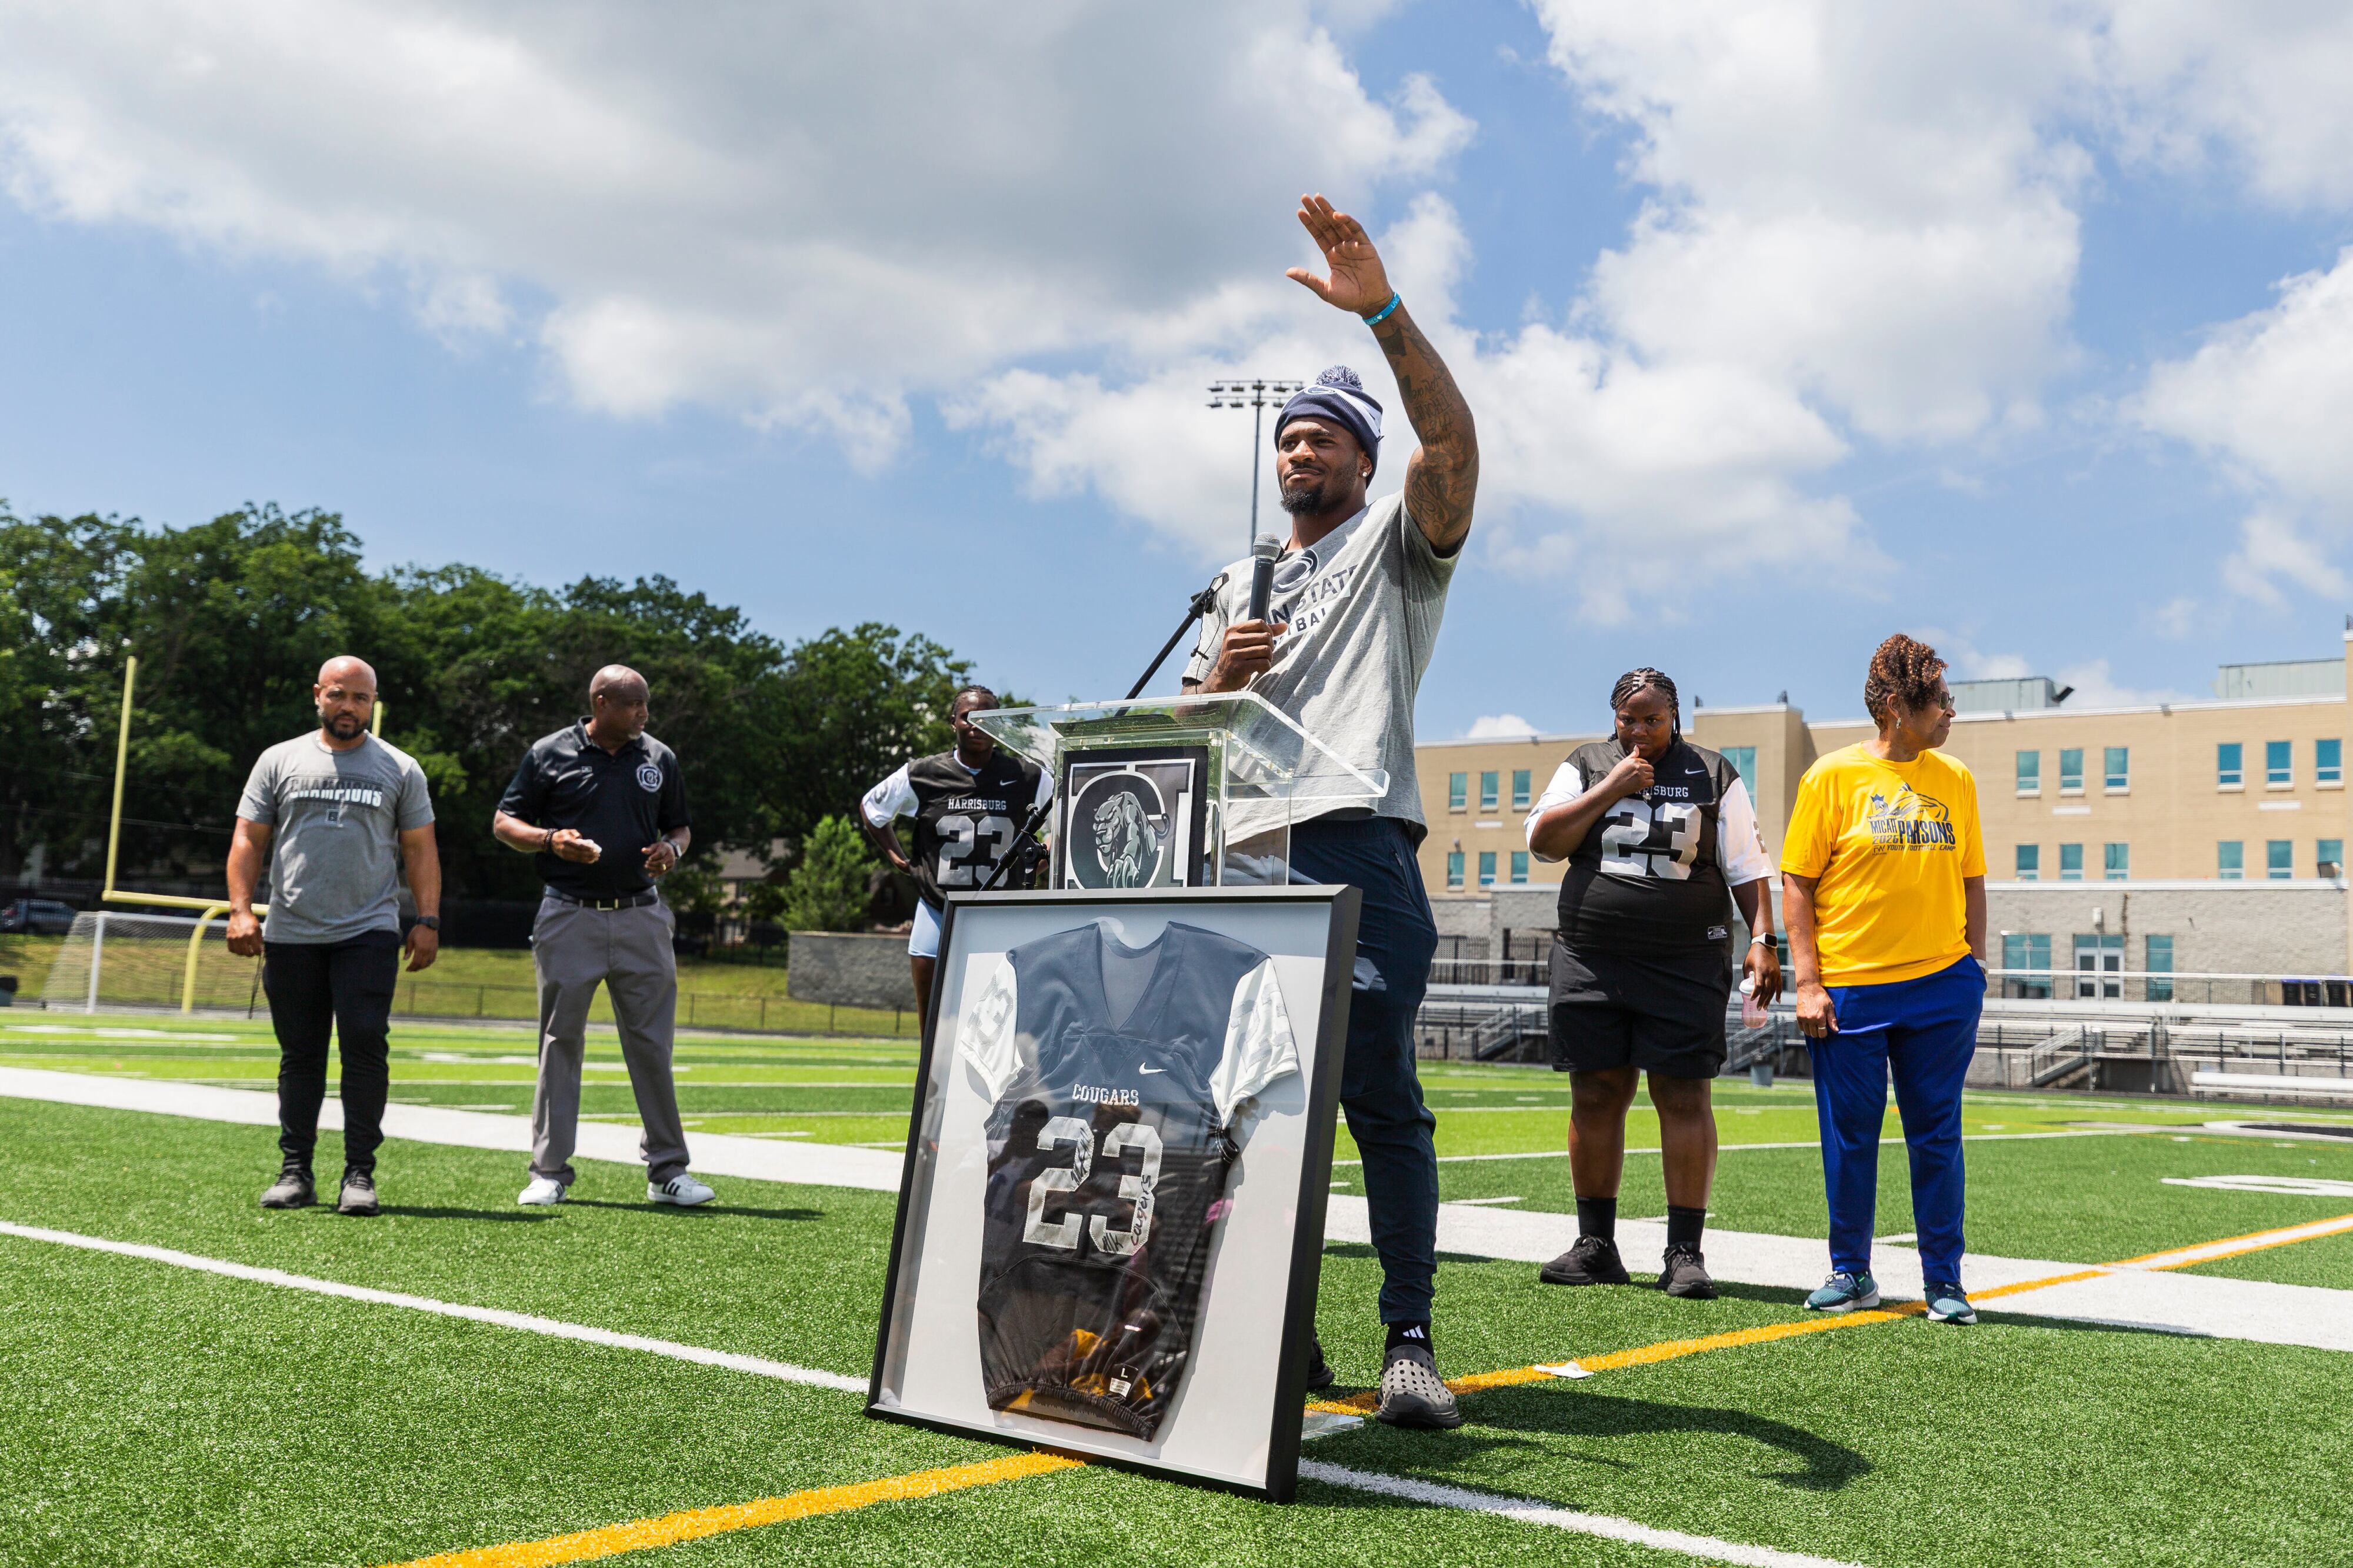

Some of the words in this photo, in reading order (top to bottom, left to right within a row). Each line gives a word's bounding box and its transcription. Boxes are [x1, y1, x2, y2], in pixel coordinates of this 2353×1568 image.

[1635, 785, 1688, 798] RISBURG
[948, 799, 1006, 810] HARRISBURG
[1871, 819, 1898, 834] MICAH
[1898, 819, 1956, 845] PARSONS
[1601, 797, 1702, 880] 23
[936, 815, 1015, 888] 23
[1072, 1083, 1139, 1106] COUGARS
[1022, 1115, 1164, 1257] 23
[1121, 1367, 1128, 1378] L
